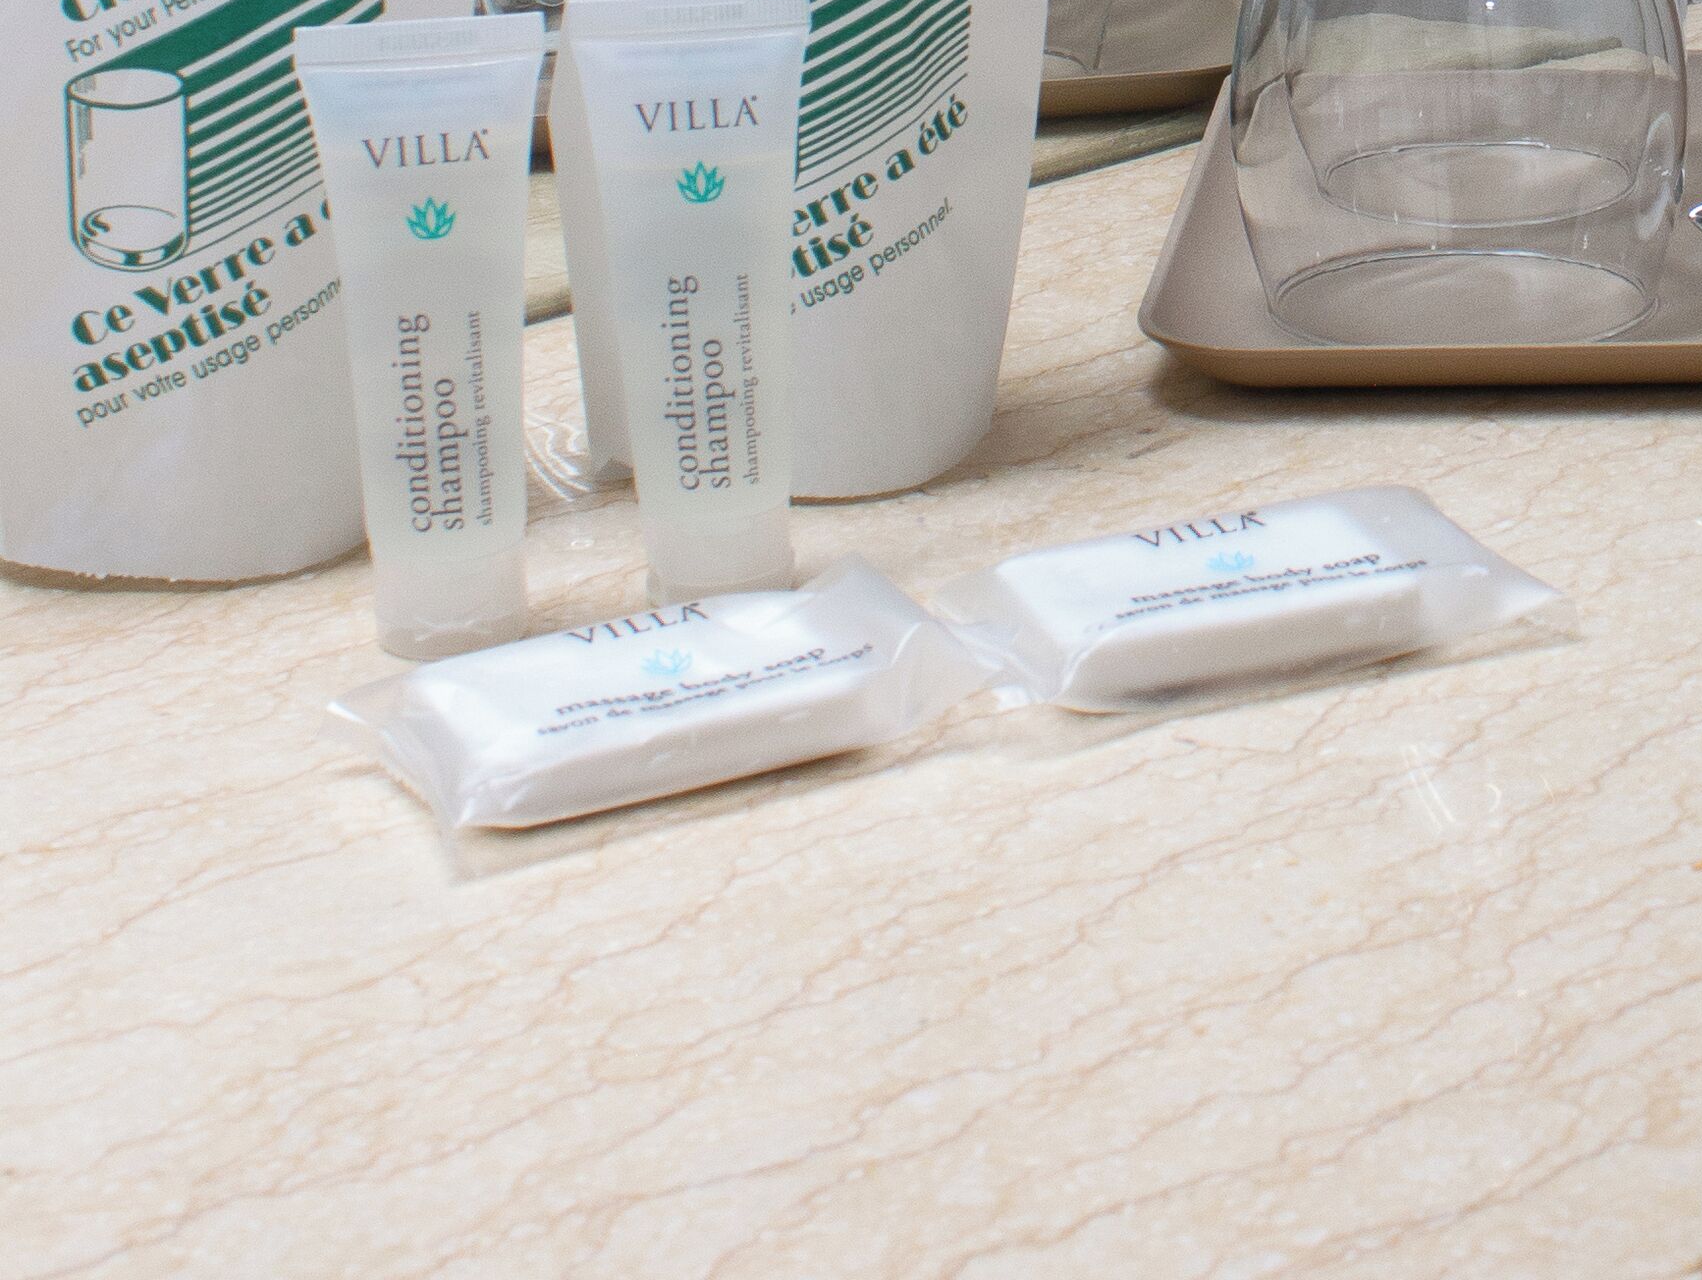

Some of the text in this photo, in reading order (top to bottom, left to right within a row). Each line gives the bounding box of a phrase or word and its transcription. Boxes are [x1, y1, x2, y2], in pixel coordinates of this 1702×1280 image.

[65, 33, 103, 61] For
[106, 7, 157, 47] your
[792, 94, 968, 236] erre a été
[71, 213, 317, 345] Ce Verre a
[800, 197, 953, 308] usage personnel.
[73, 280, 272, 392] aseptisé
[75, 393, 130, 428] pour
[132, 370, 187, 400] votre
[191, 335, 261, 379] usage
[662, 275, 699, 490] conditioning
[734, 272, 761, 485] shampooing revitalisant
[392, 314, 431, 533] conditioning
[430, 378, 469, 530] shampoo
[465, 311, 494, 526] shampooing revitalisant
[698, 340, 735, 489] shampoo
[1115, 603, 1173, 620] savon
[1180, 596, 1201, 606] de
[1210, 581, 1290, 600] massage
[1131, 553, 1380, 603] massage body soap
[556, 647, 824, 716] massage body soap
